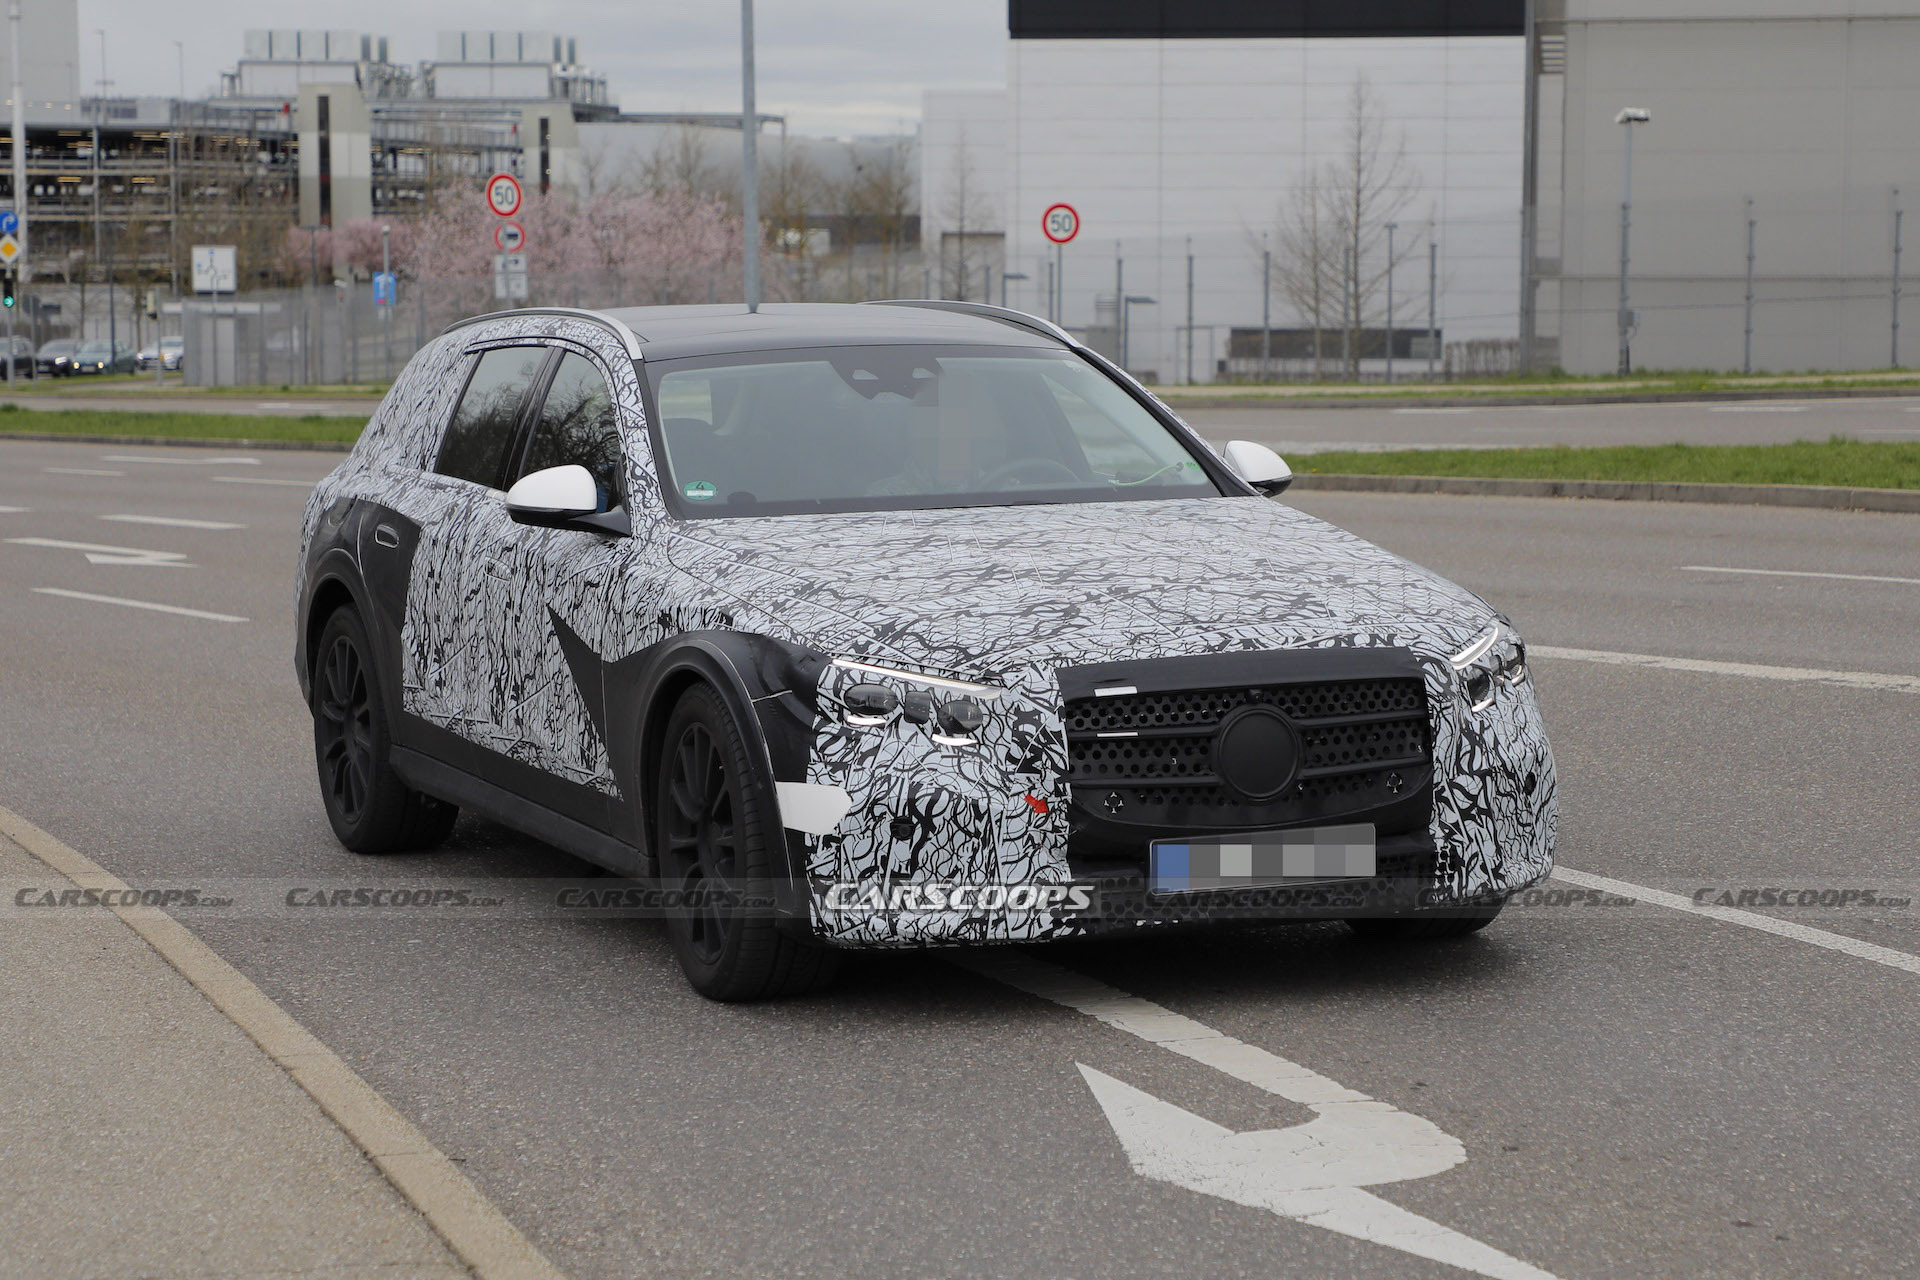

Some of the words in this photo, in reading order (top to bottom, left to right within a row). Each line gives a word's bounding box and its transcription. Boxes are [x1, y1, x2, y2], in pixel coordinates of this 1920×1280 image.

[494, 185, 514, 205] 50
[1051, 213, 1073, 233] 50
[696, 481, 705, 491] 4
